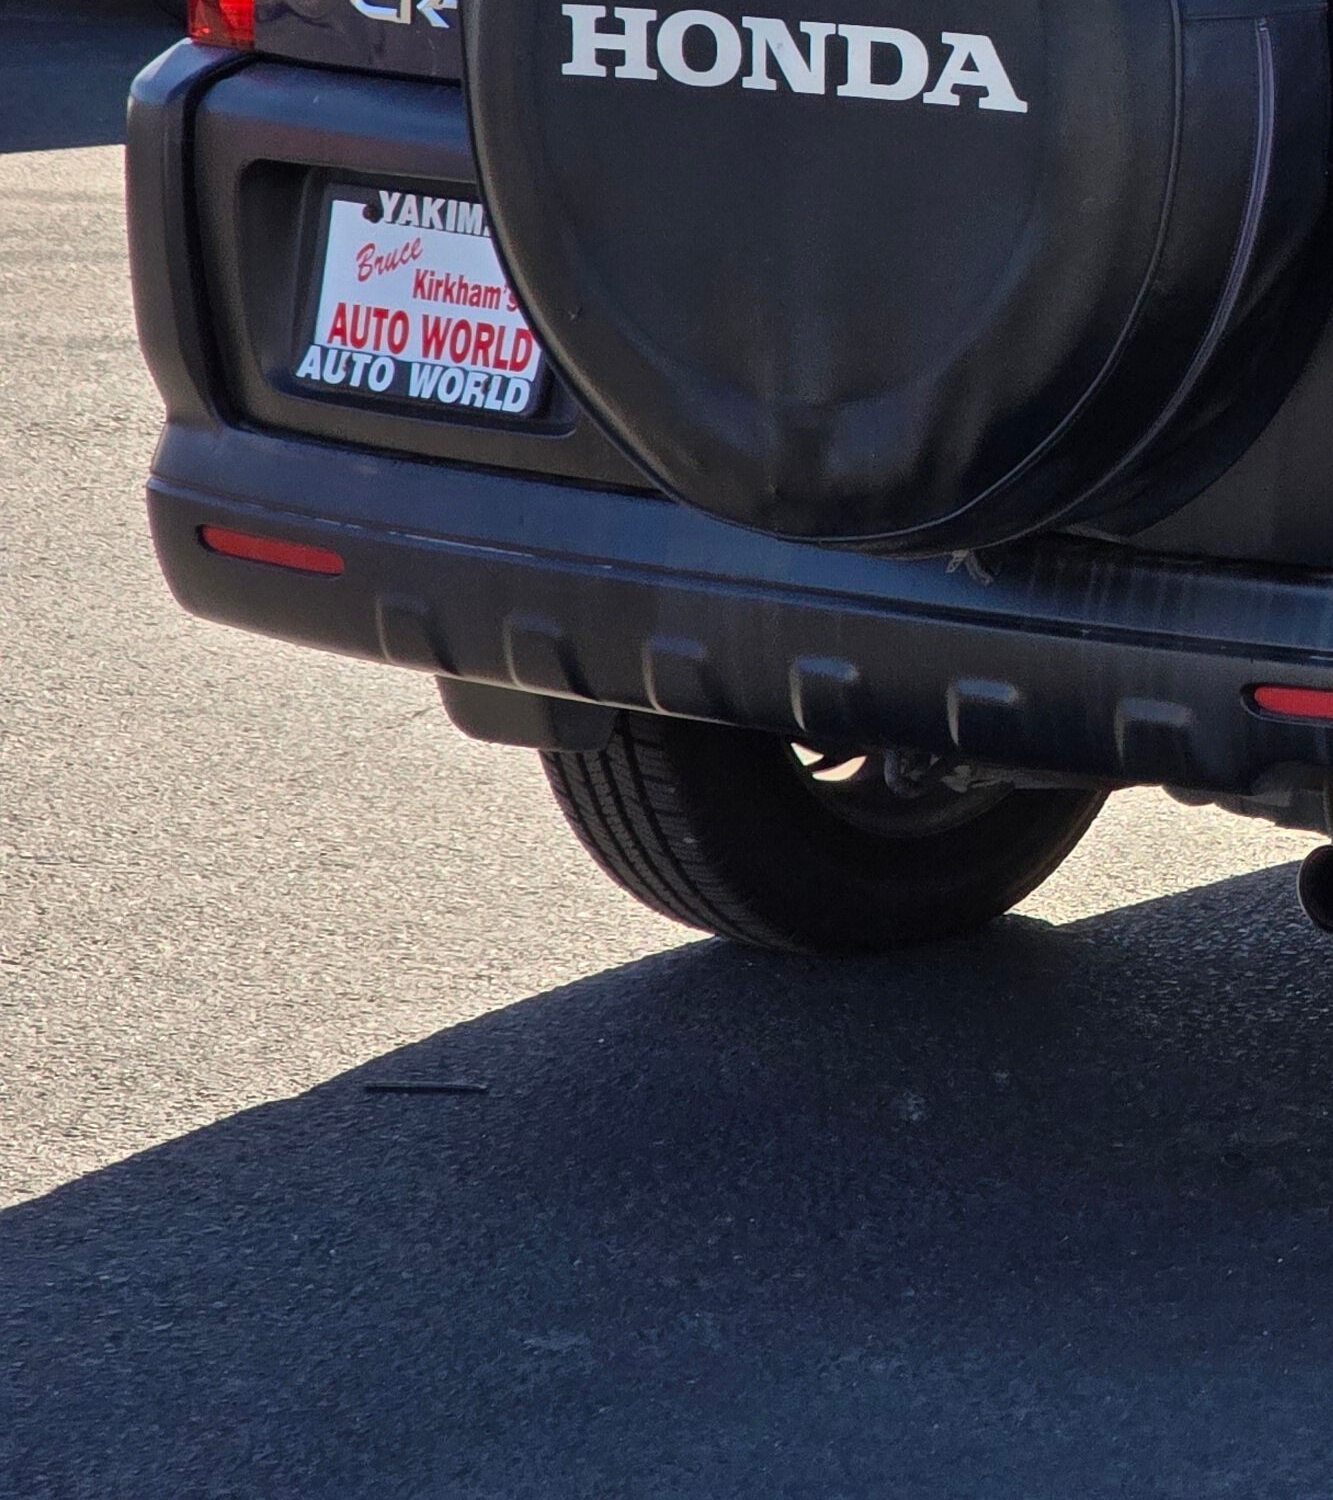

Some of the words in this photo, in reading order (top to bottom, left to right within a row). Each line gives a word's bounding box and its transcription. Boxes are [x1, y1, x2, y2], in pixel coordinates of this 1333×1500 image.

[561, 3, 1028, 113] HONDA
[379, 190, 489, 237] YAKIM
[356, 237, 423, 282] Bruce
[412, 268, 518, 312] Kirkham's
[327, 302, 409, 355] AUTO
[421, 313, 533, 373] WORLD
[296, 345, 396, 393] AUTO
[408, 362, 531, 414] WORLD
